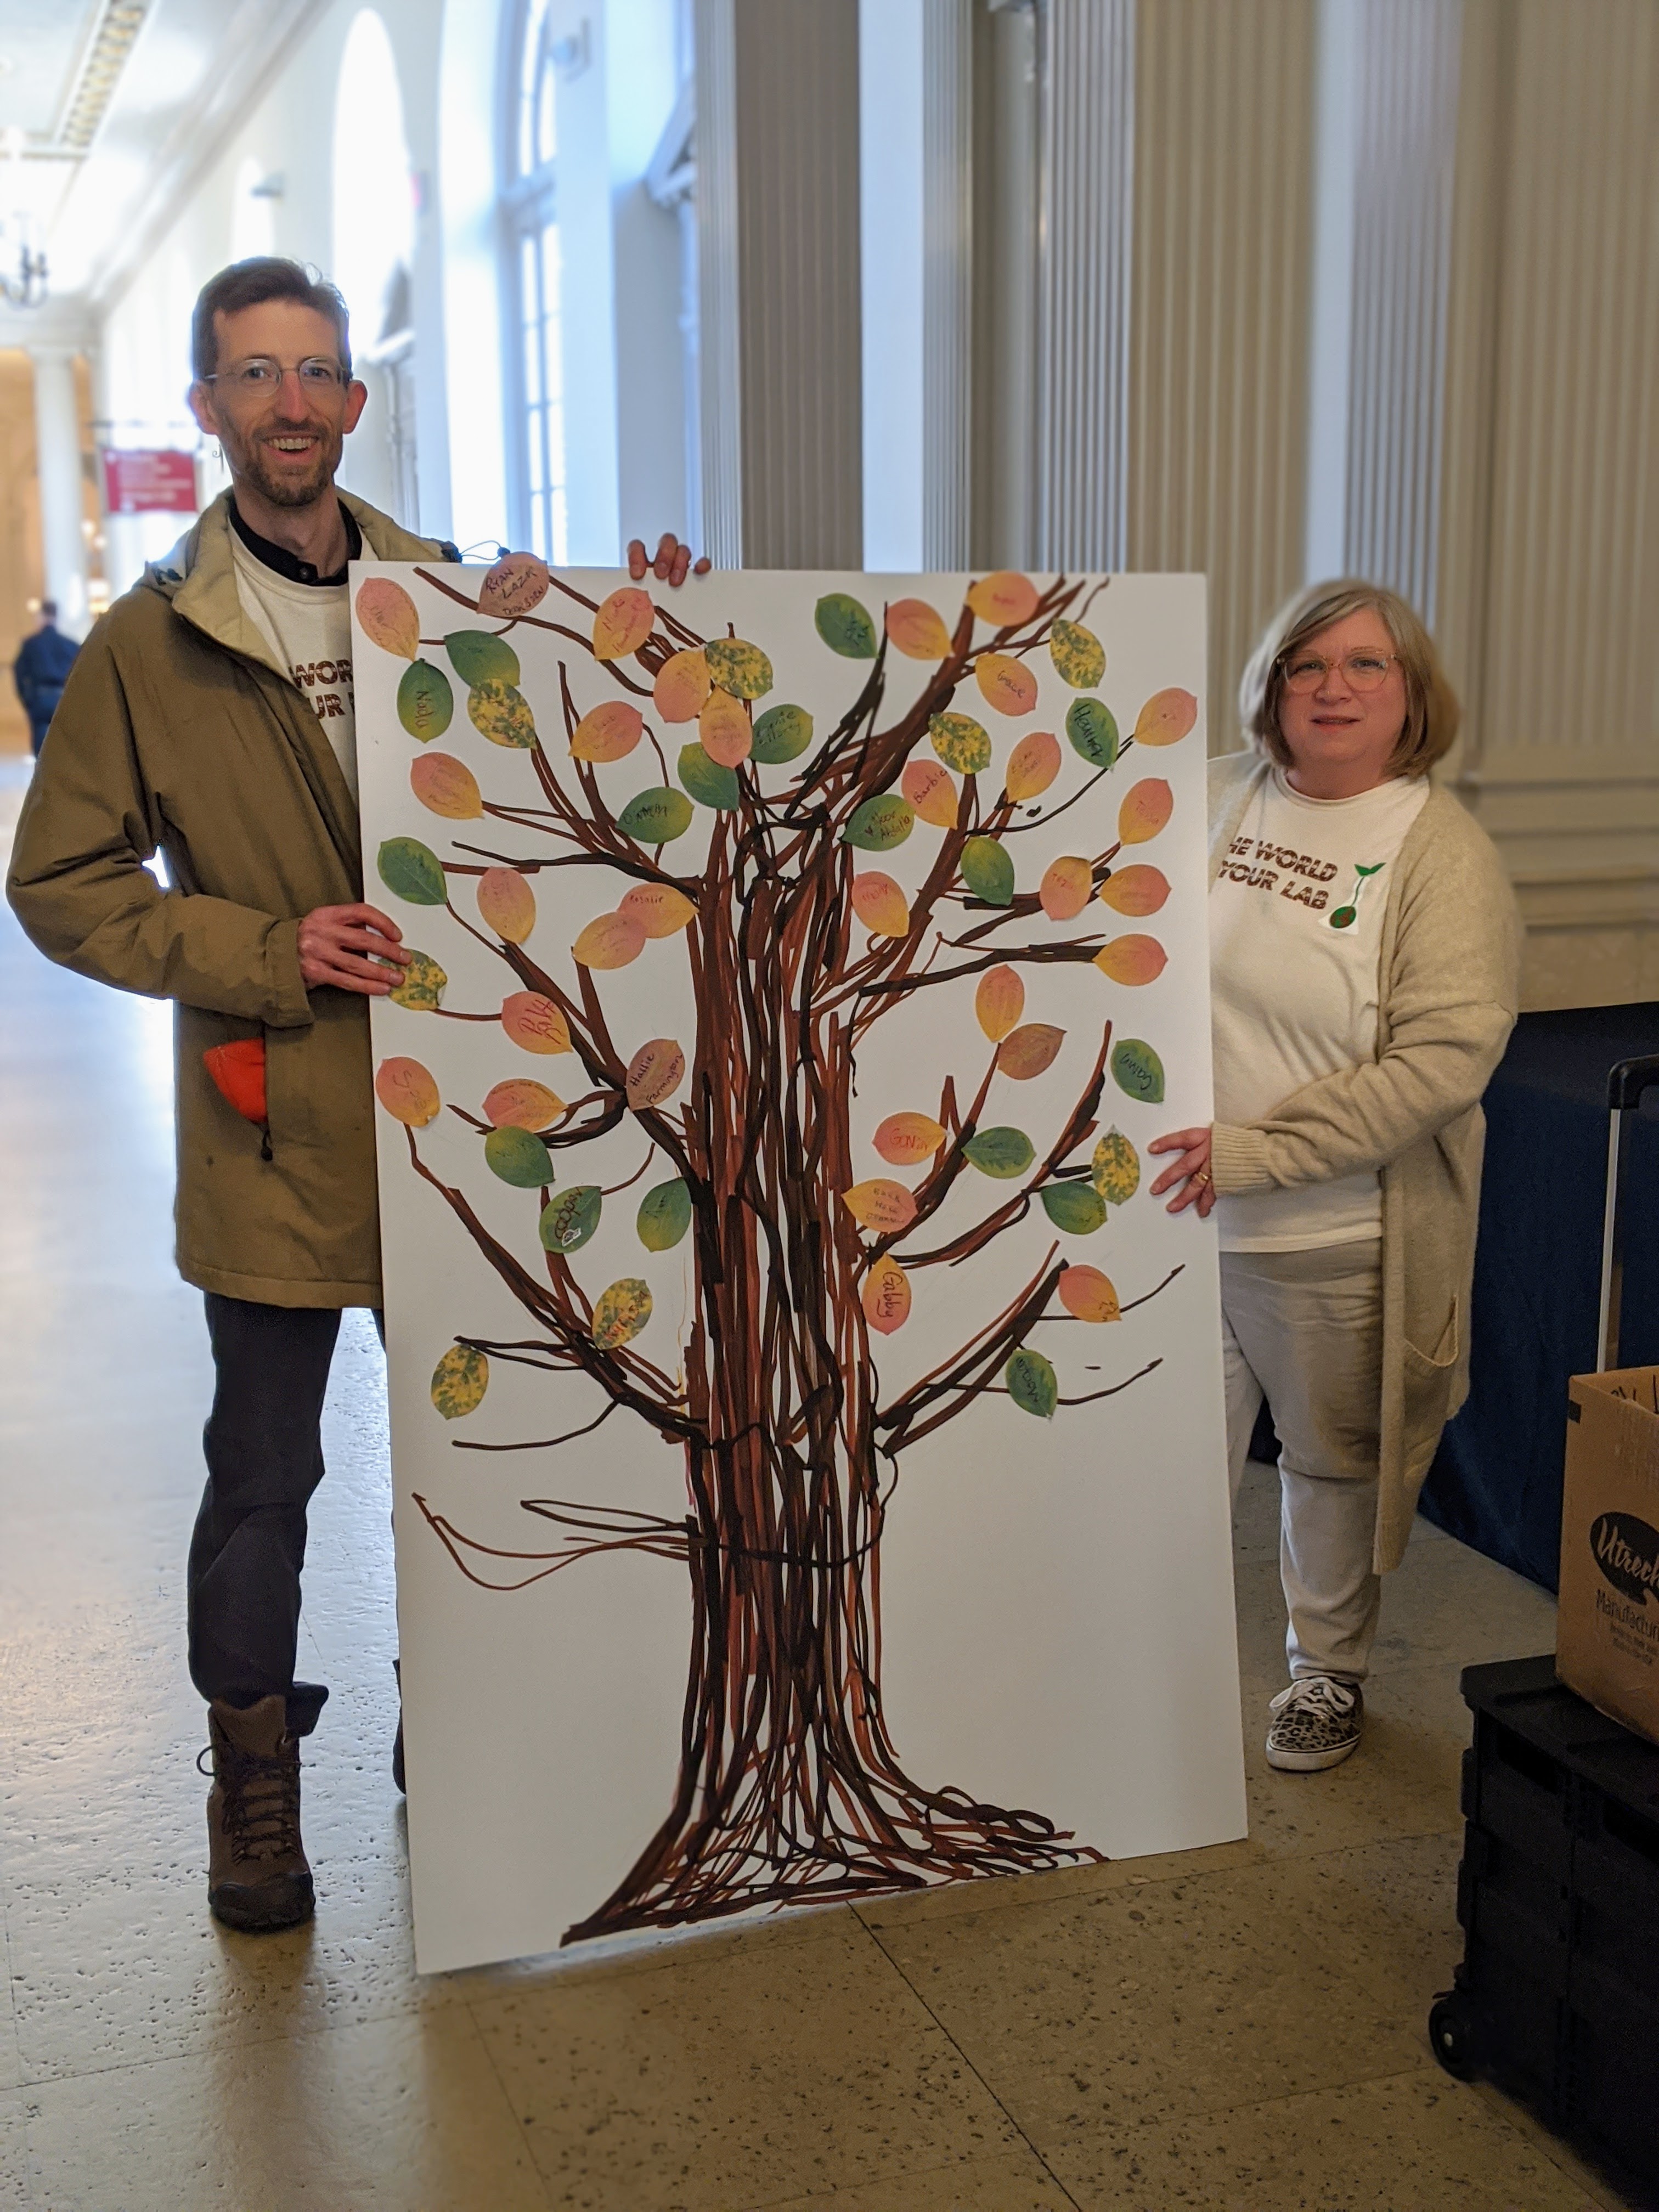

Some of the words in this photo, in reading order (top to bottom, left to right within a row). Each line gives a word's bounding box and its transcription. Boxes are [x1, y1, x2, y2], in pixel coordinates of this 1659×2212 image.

[486, 567, 514, 592] RYAN
[913, 769, 947, 804] Barbie
[1255, 840, 1338, 882] WORLD
[1218, 860, 1279, 890] YOUR
[1280, 881, 1329, 910] LAB
[630, 1052, 654, 1087] Hallie
[876, 1271, 904, 1318] Gabby
